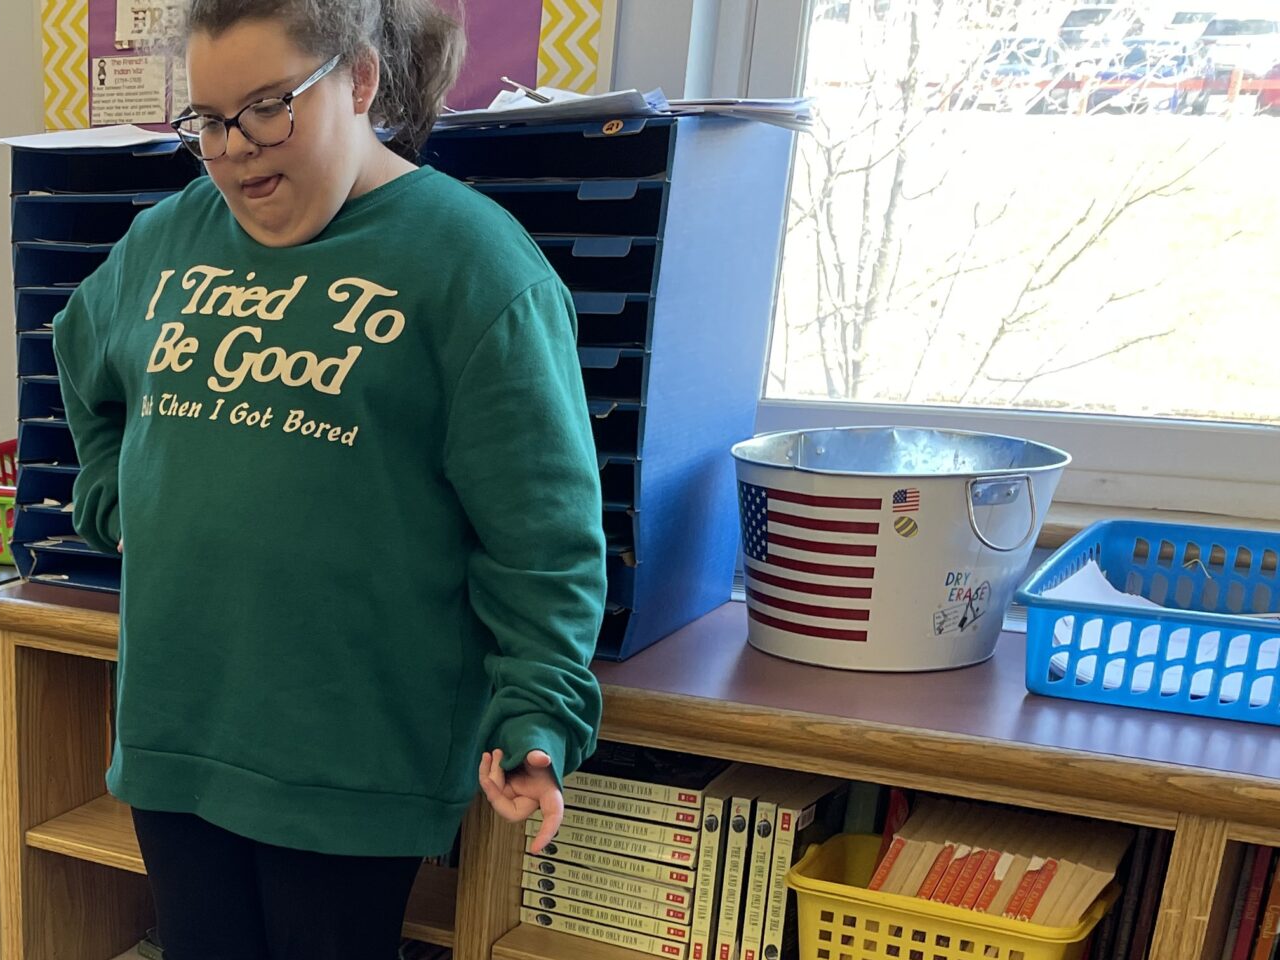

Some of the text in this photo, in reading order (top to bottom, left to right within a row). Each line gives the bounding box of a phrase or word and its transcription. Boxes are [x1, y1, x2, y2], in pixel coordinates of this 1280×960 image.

[145, 265, 405, 343] I Tried To
[146, 322, 362, 395] Be Good
[159, 393, 202, 418] Then
[209, 399, 225, 420] I
[230, 402, 273, 428] Got
[283, 410, 358, 446] Bored
[945, 572, 971, 586] DRY
[948, 586, 987, 601] ERASE
[576, 776, 652, 796] THE ONE AND ONLY IVAN
[574, 794, 650, 815] THE ONE AND ONLY IVAN
[573, 815, 648, 836] THE ONE AND ONLY IVAN
[572, 832, 646, 853] THE ONE AND ONLY IVAN
[571, 850, 644, 872] THE ONE AND ONLY IVAN
[569, 903, 643, 927] THE ONE AND ONLY IVAN
[565, 921, 637, 945] THE ONE AND ONLY IVAN
